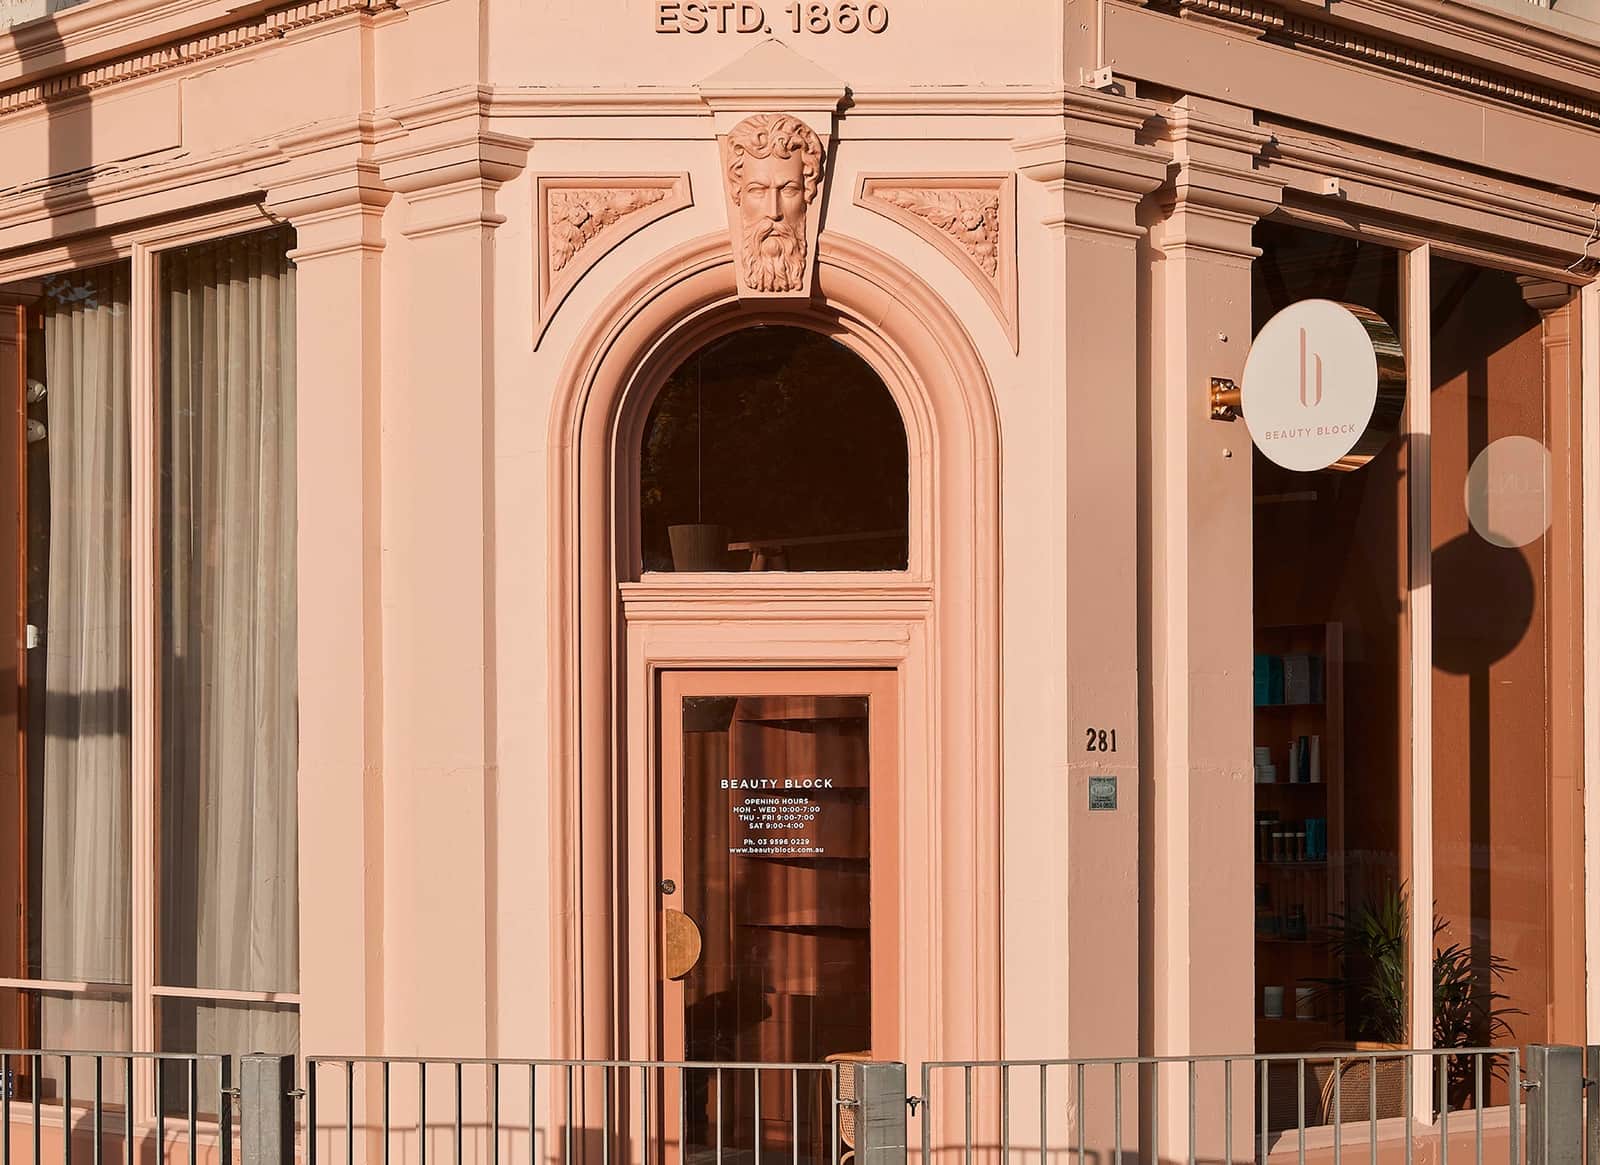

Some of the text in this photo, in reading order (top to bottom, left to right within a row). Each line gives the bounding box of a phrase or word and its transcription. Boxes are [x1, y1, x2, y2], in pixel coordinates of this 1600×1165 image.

[655, 1, 889, 34] ESTD. 1860
[1265, 424, 1355, 440] BEAUTY BLOCK
[1086, 728, 1117, 752] 281
[720, 779, 833, 789] BEAUTY BLOCK
[729, 846, 824, 854] www.beautyblock.com.au
